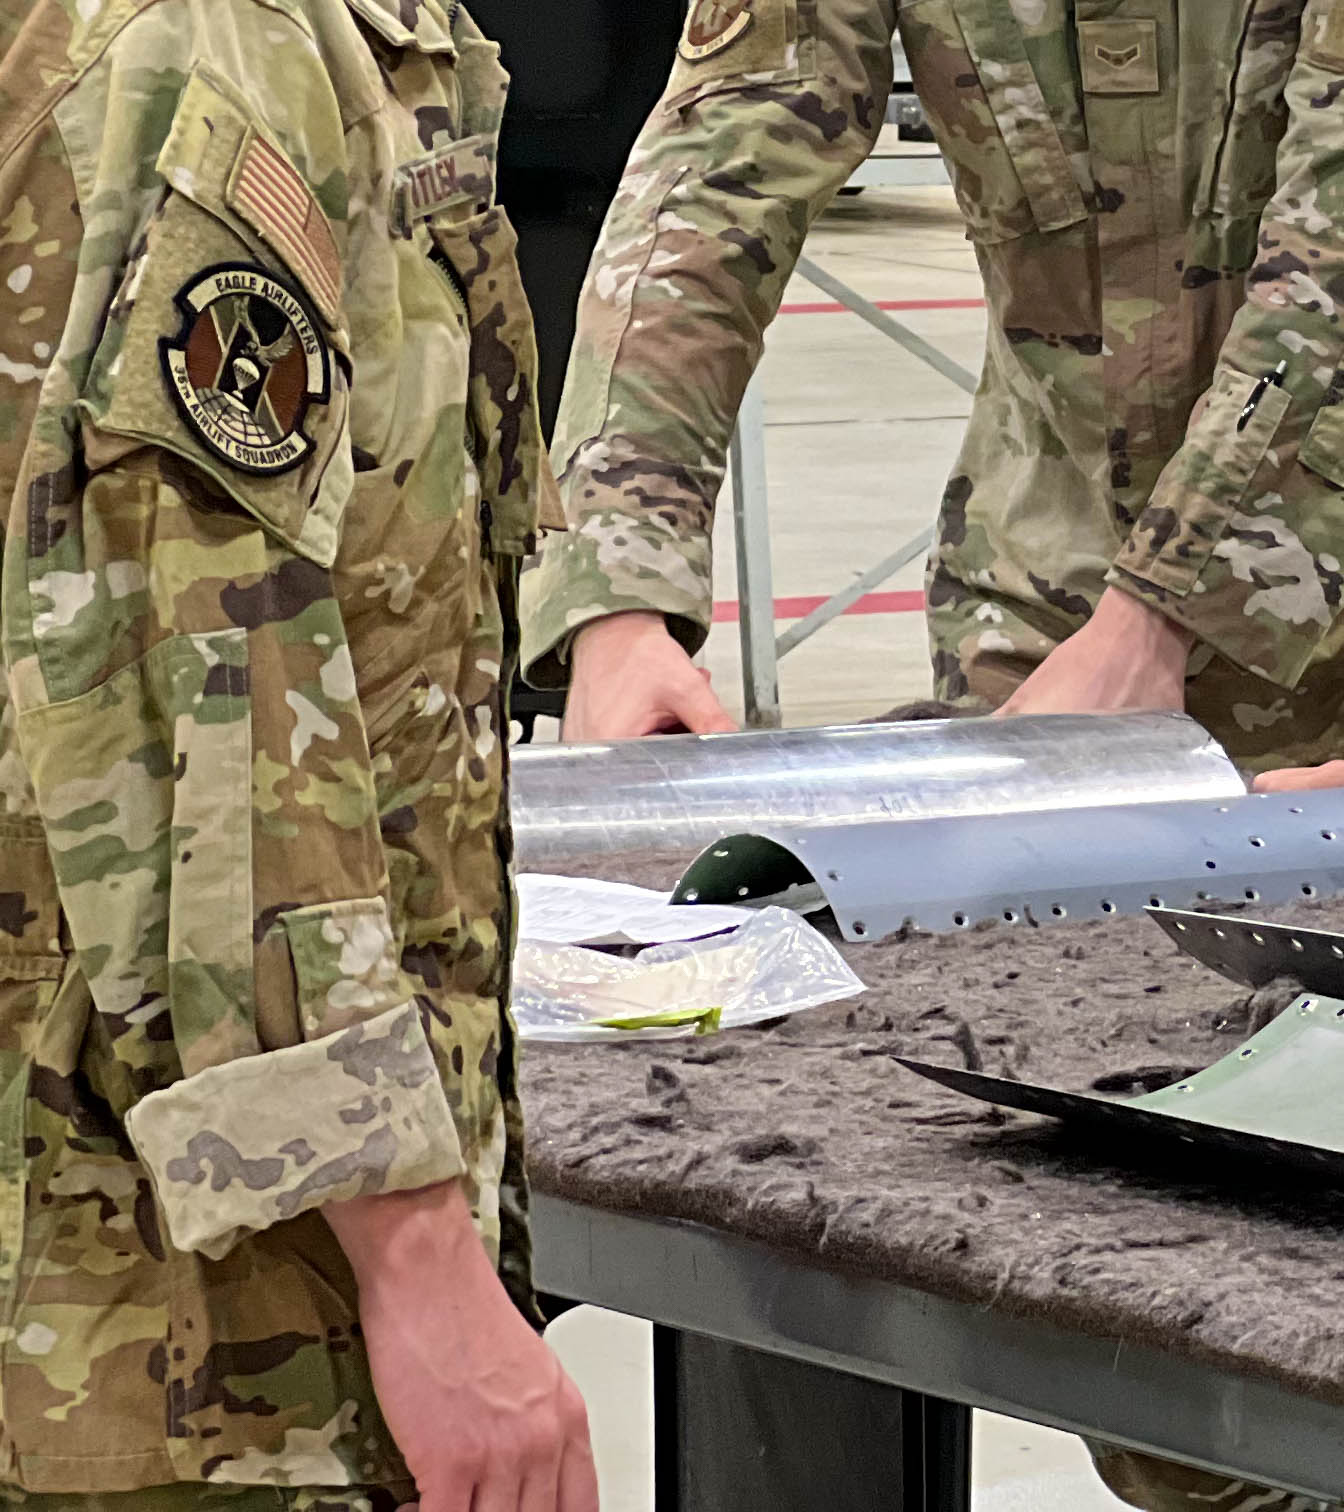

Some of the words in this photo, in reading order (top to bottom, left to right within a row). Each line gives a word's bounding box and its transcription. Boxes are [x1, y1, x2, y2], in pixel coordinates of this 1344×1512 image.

[215, 276, 258, 294] EAGLE
[261, 278, 319, 356] AIRLIFTERS
[189, 402, 231, 452] AIRLIFT
[235, 442, 298, 465] SQUADRON
